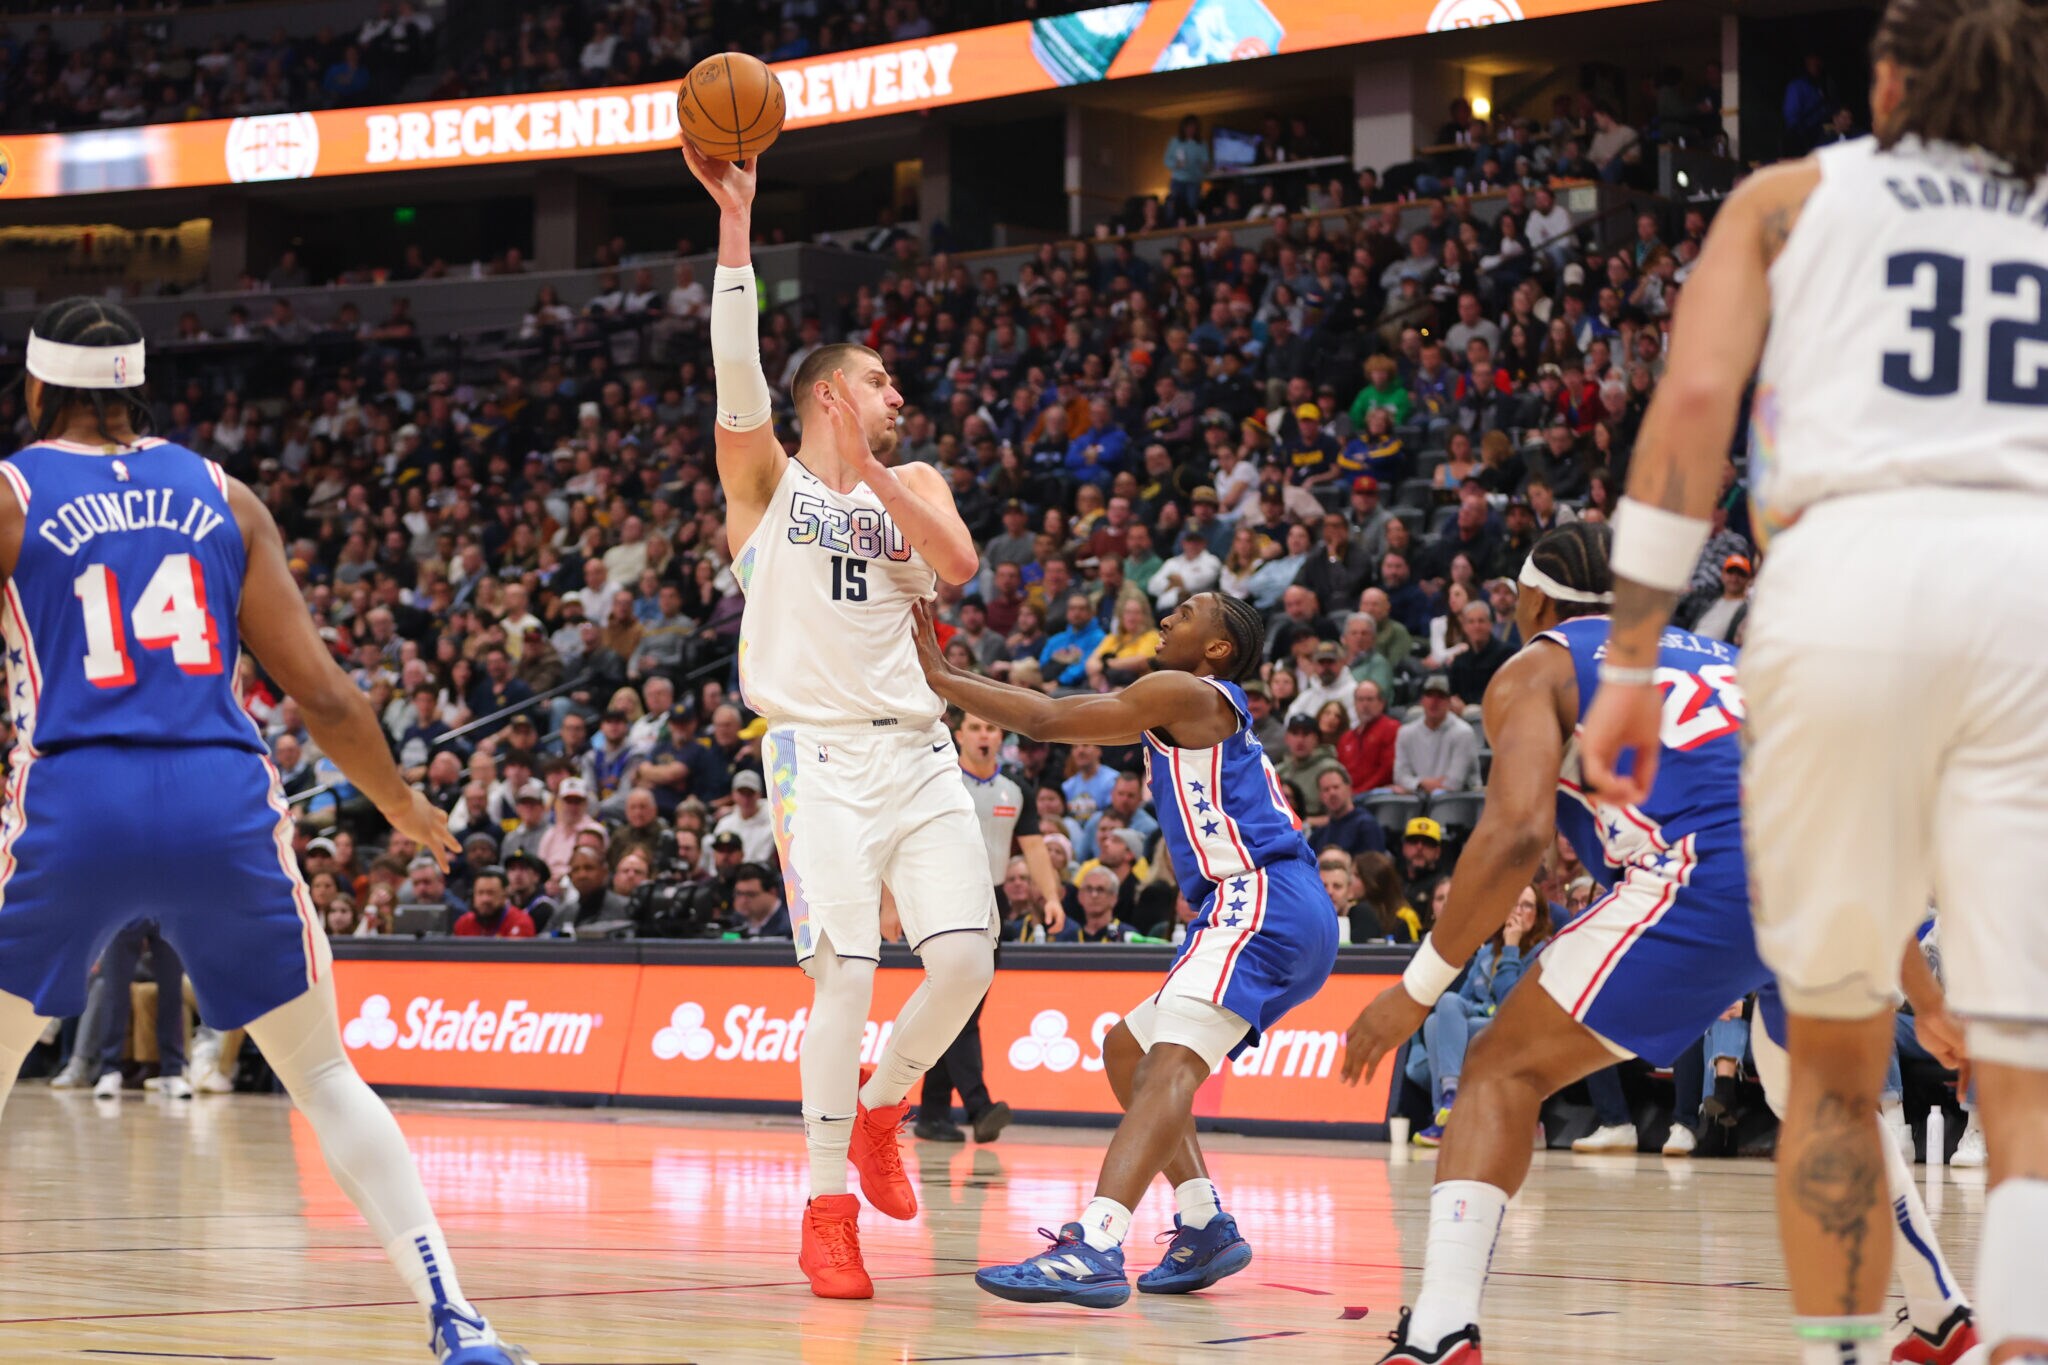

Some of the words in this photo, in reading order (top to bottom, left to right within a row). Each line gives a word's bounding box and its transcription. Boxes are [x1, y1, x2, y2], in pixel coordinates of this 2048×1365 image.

[365, 91, 679, 163] BRECKENRID
[784, 43, 958, 120] REWERY
[1882, 252, 2048, 406] 32
[39, 488, 178, 556] COUNCIL
[179, 497, 224, 542] IV
[788, 492, 912, 562] 5280
[74, 553, 224, 689] 14
[831, 556, 868, 601] 15
